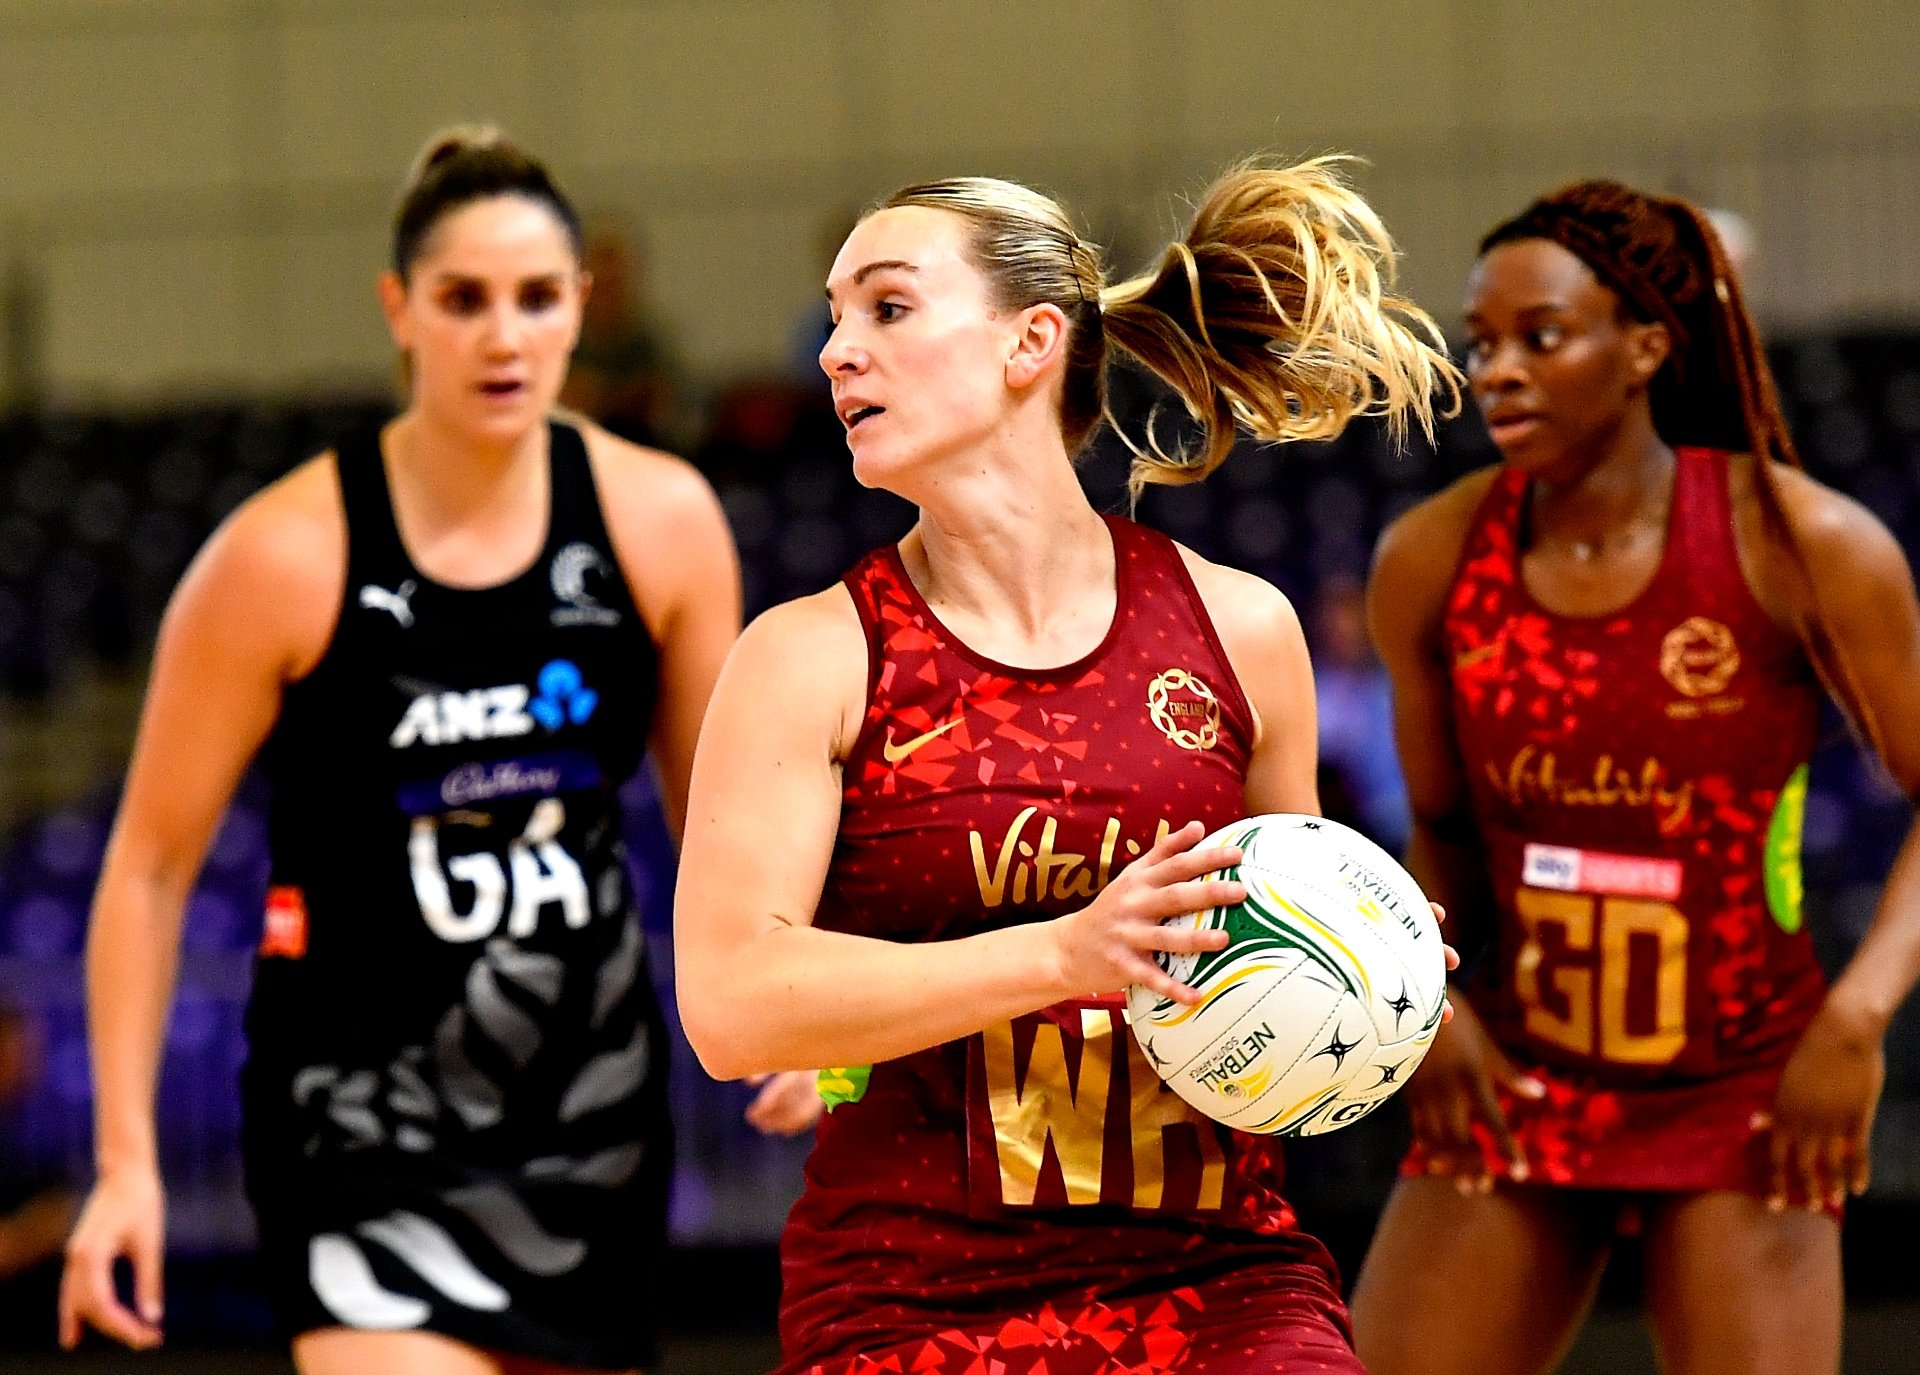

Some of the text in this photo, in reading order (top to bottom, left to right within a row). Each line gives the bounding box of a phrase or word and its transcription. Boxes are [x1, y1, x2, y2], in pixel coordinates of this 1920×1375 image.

[389, 684, 536, 748] ANZ
[1168, 701, 1205, 717] ENGLAND
[407, 798, 592, 943] GA
[969, 806, 1170, 907] Vital
[1338, 859, 1422, 940] NETBALL
[1515, 888, 1690, 1065] GD
[1196, 1021, 1276, 1093] NETBALL
[1211, 1035, 1240, 1062] SOUTH
